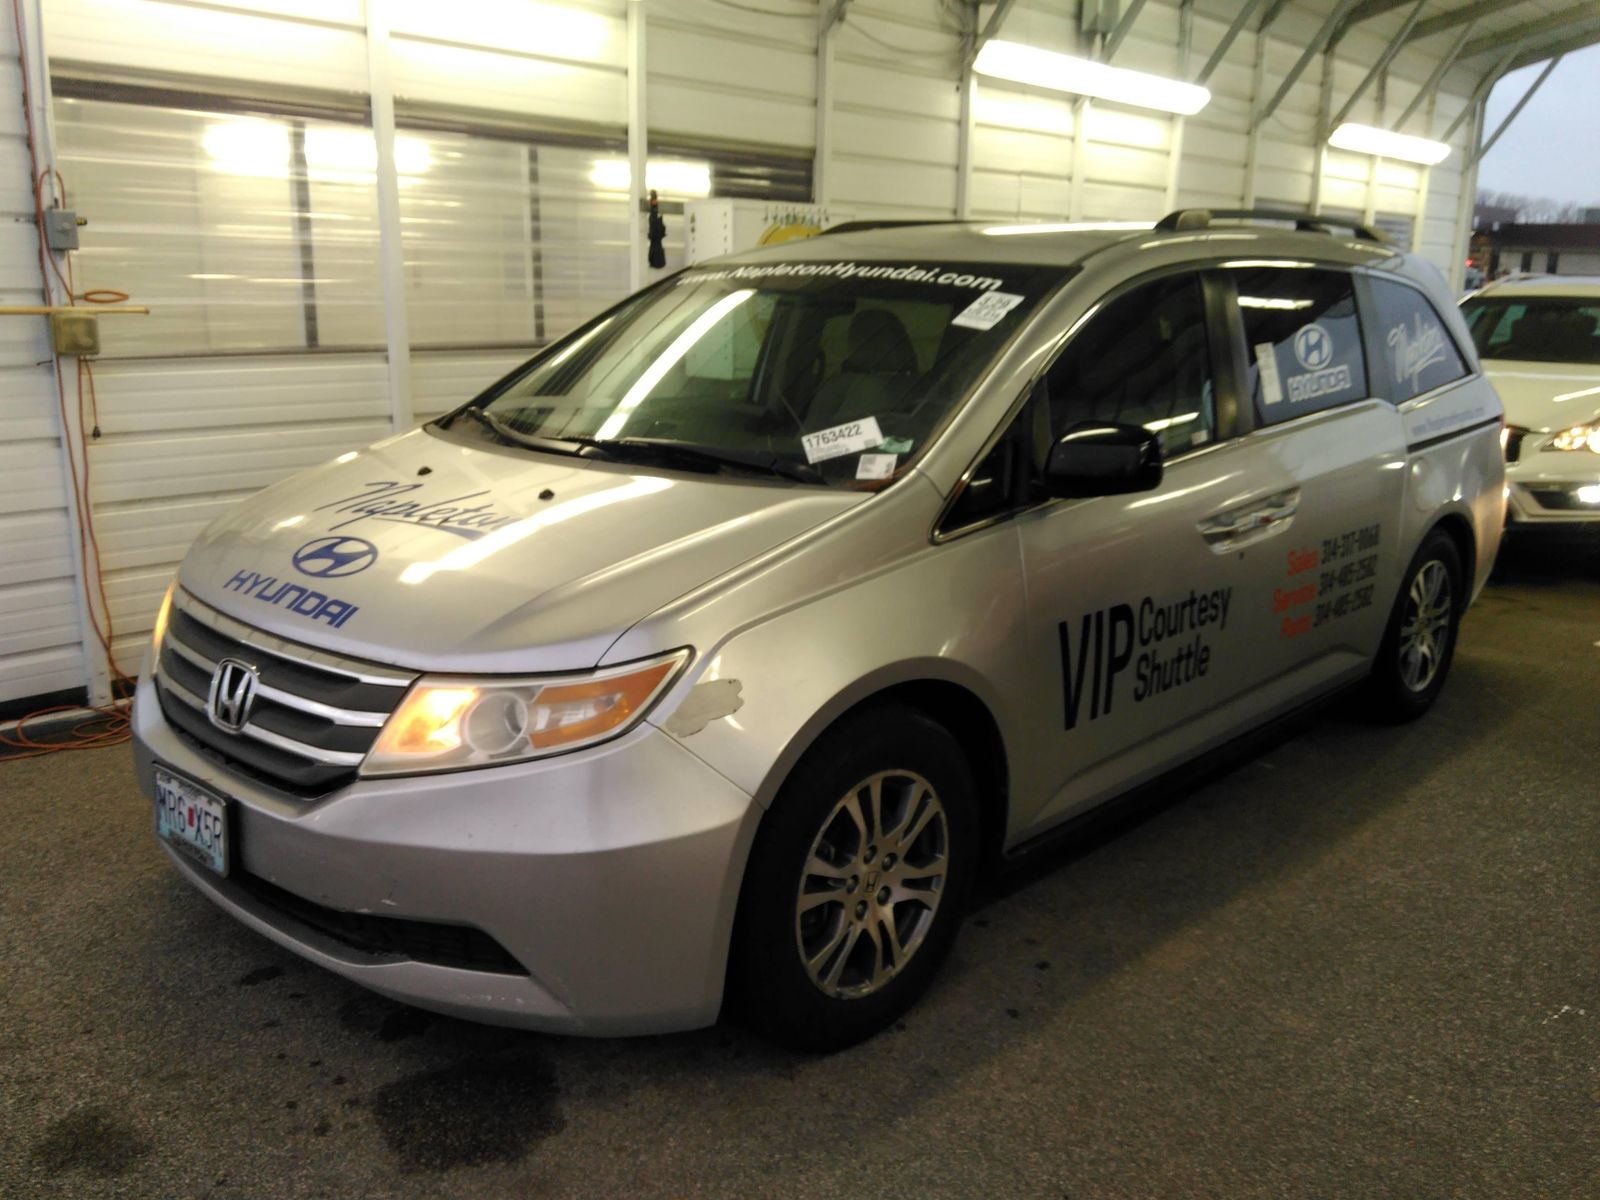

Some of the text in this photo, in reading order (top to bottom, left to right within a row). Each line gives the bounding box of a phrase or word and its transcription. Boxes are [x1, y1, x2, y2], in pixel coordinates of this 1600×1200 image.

[806, 423, 863, 449] 1763422
[223, 569, 359, 629] HYUNDAI
[1138, 586, 1233, 646] Courtesy
[1058, 604, 1135, 731] VIP
[1133, 634, 1211, 702] Shuttle
